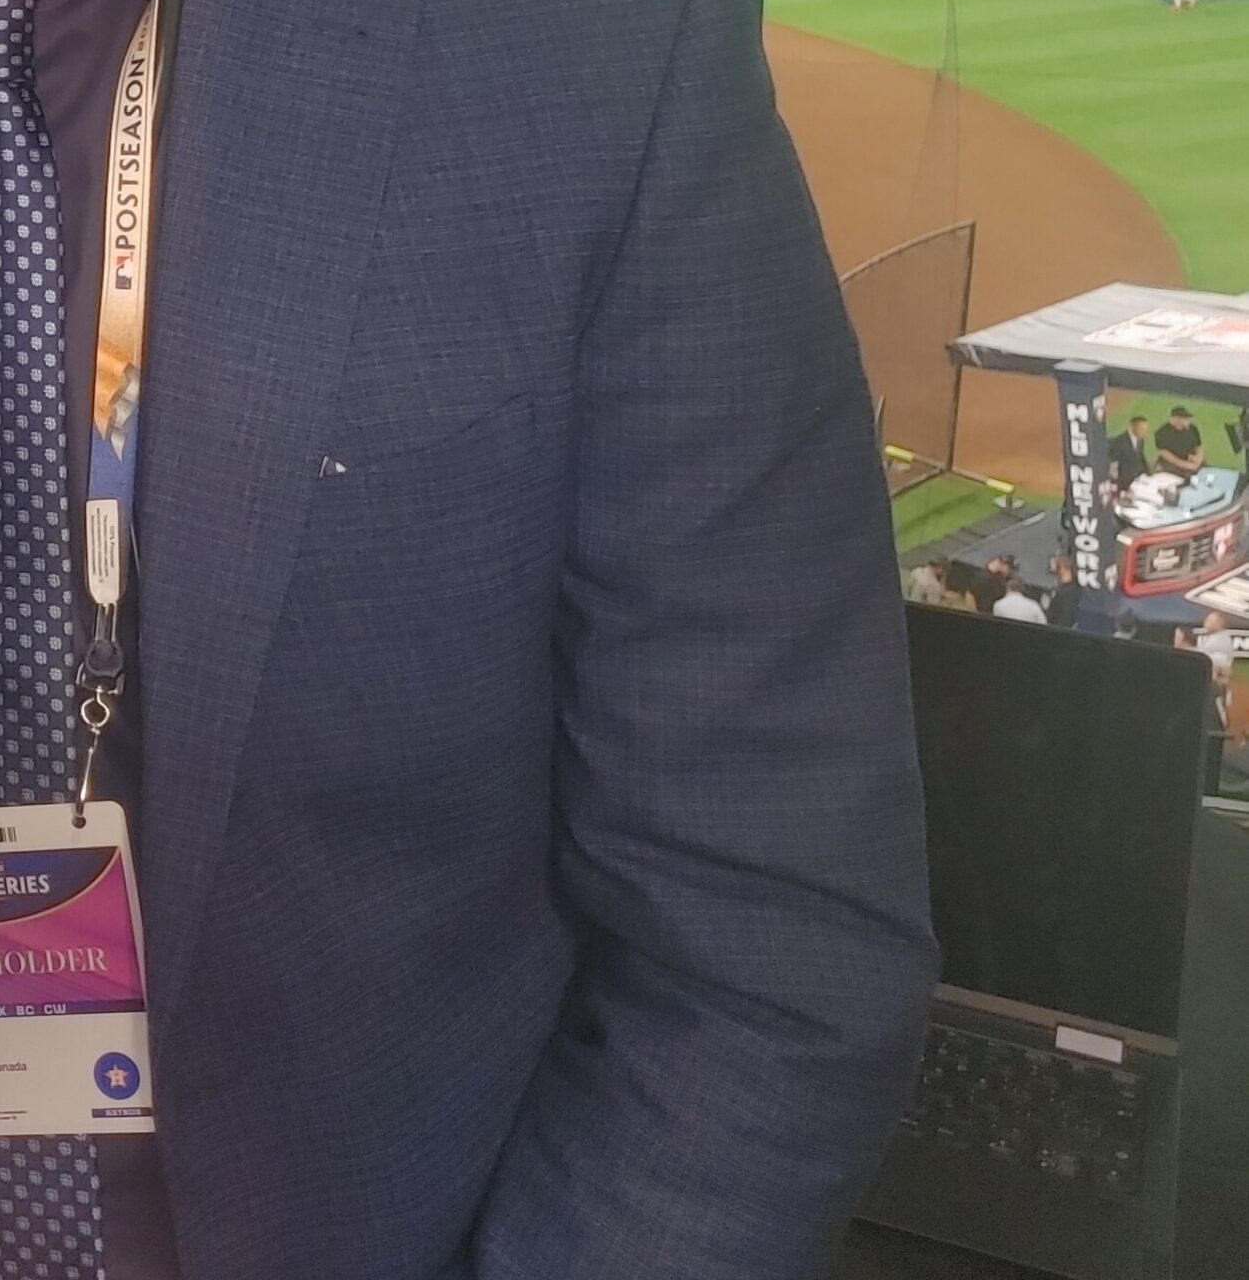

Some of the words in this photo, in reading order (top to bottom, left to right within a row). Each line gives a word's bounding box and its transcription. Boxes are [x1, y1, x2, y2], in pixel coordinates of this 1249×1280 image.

[116, 58, 146, 250] POSTSEASON
[1069, 465, 1101, 590] NETWORK
[16, 1005, 34, 1016] BC
[43, 1004, 66, 1015] CW
